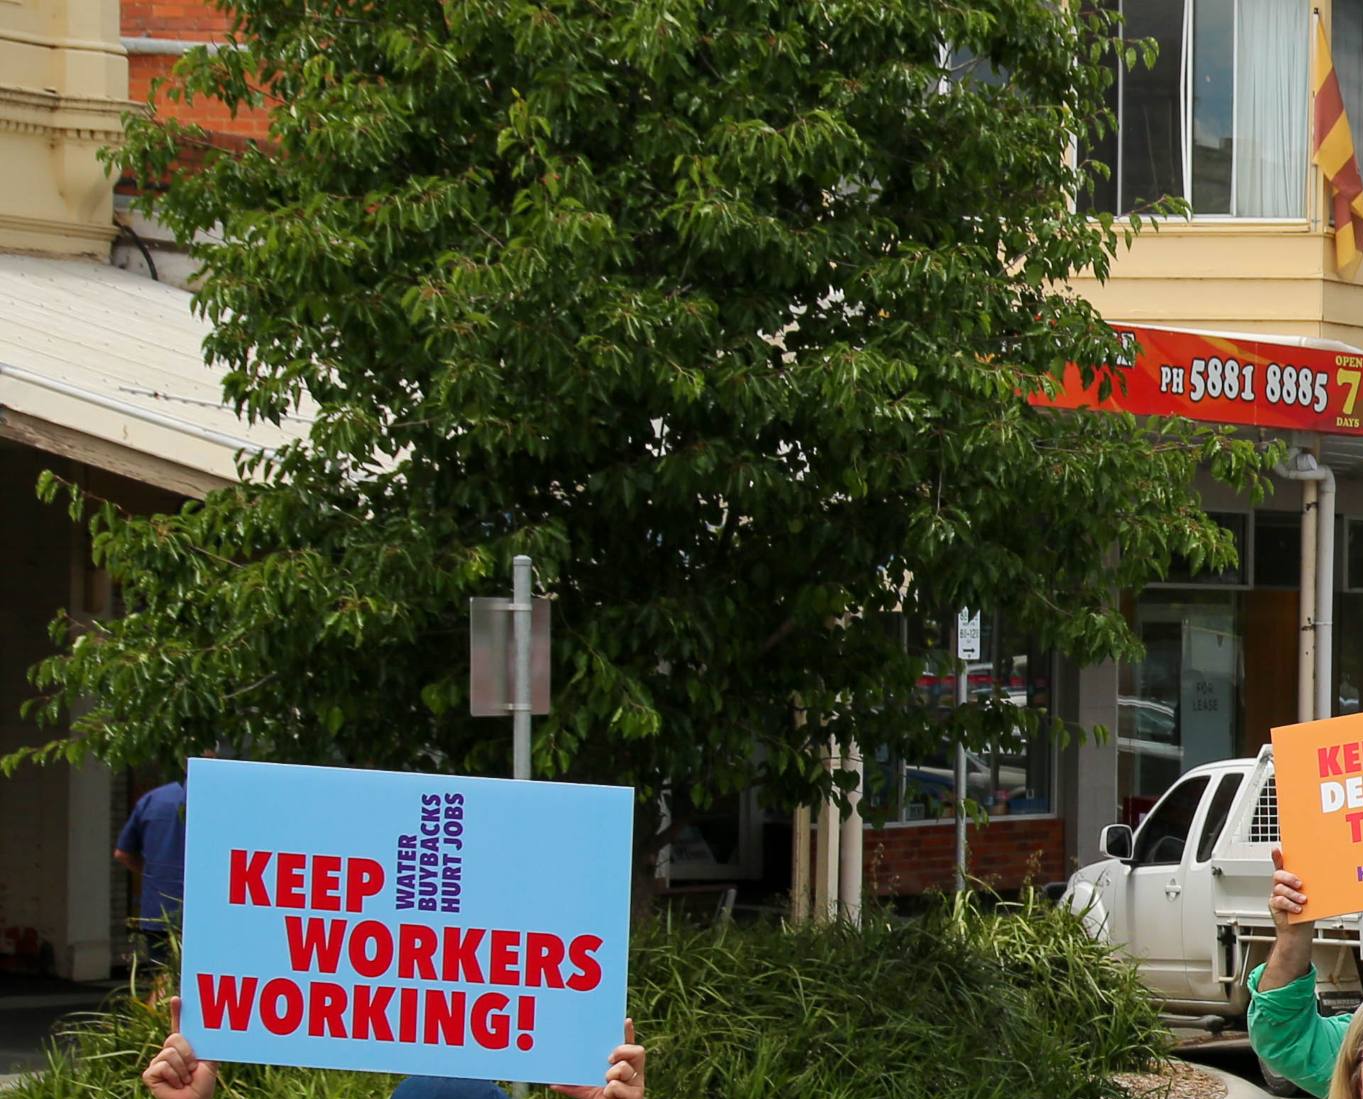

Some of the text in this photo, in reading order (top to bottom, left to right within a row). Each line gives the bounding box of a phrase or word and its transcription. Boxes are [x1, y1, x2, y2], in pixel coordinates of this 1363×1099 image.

[1160, 357, 1328, 412] PH 5881 8885
[1335, 355, 1363, 368] OPEN
[1337, 369, 1361, 415] 7
[1336, 416, 1360, 428] DAYS
[229, 849, 385, 913] KEEP
[395, 834, 418, 911] WATER
[418, 793, 441, 912] BUYBACKS
[441, 792, 465, 913] HURT JOBS
[285, 915, 604, 992] WORKERS
[197, 973, 536, 1052] WORKING!
